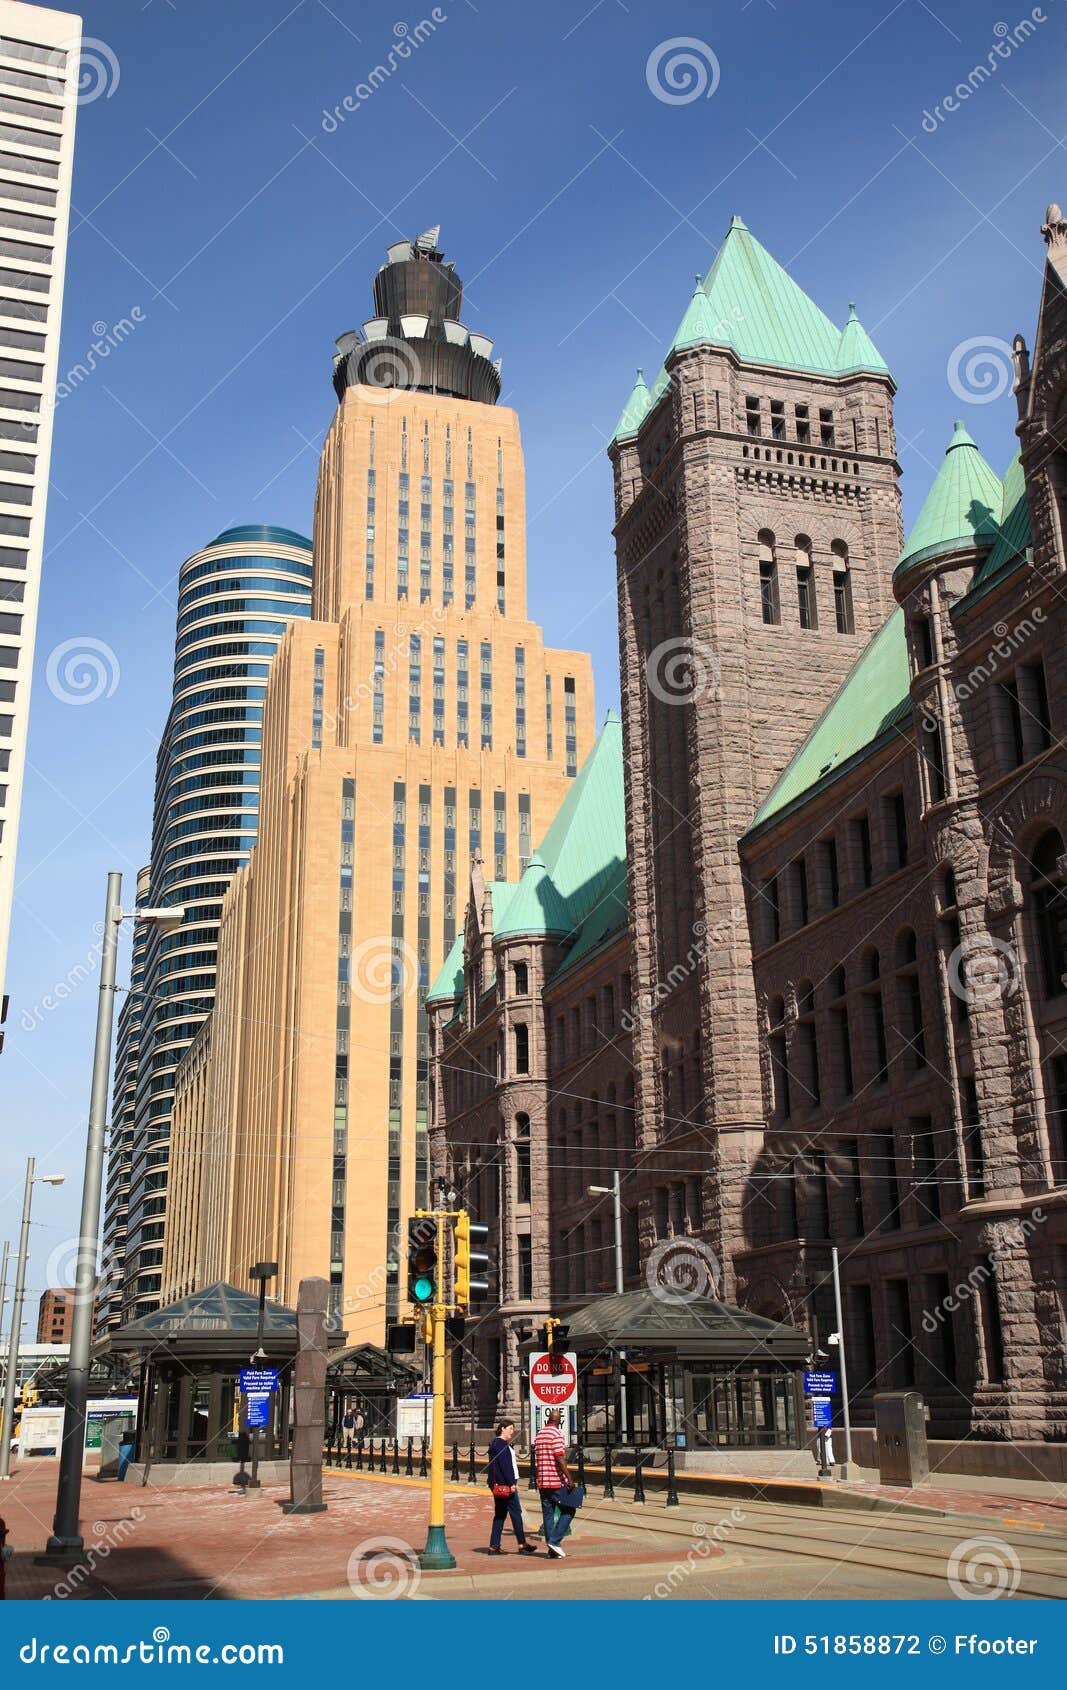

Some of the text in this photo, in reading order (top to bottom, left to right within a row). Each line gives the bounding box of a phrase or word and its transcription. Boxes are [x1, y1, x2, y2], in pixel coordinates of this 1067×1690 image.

[536, 1363, 569, 1372] DO NOT
[540, 1386, 567, 1395] ENTER
[545, 1407, 565, 1418] OE
